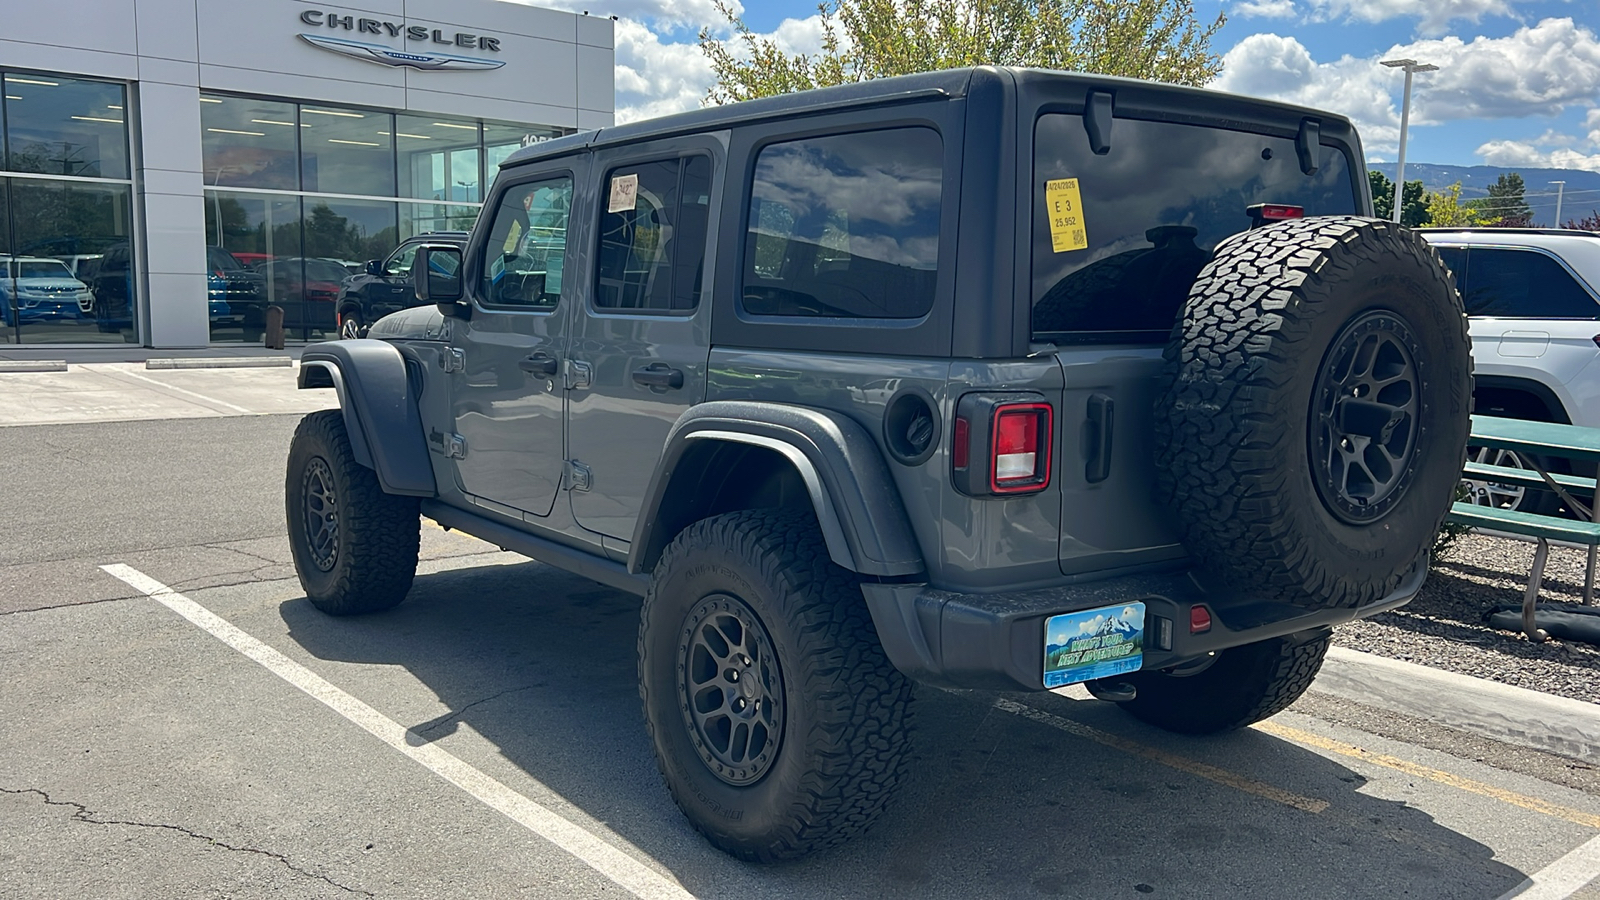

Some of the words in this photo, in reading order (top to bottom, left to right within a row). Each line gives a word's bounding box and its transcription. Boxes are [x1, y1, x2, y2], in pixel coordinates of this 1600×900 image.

[300, 10, 502, 52] CHRYSLER
[1055, 201, 1061, 213] E
[1066, 200, 1072, 211] 3
[1055, 217, 1076, 228] 25,952
[1101, 633, 1124, 648] YOUR
[1057, 652, 1082, 667] NEXT
